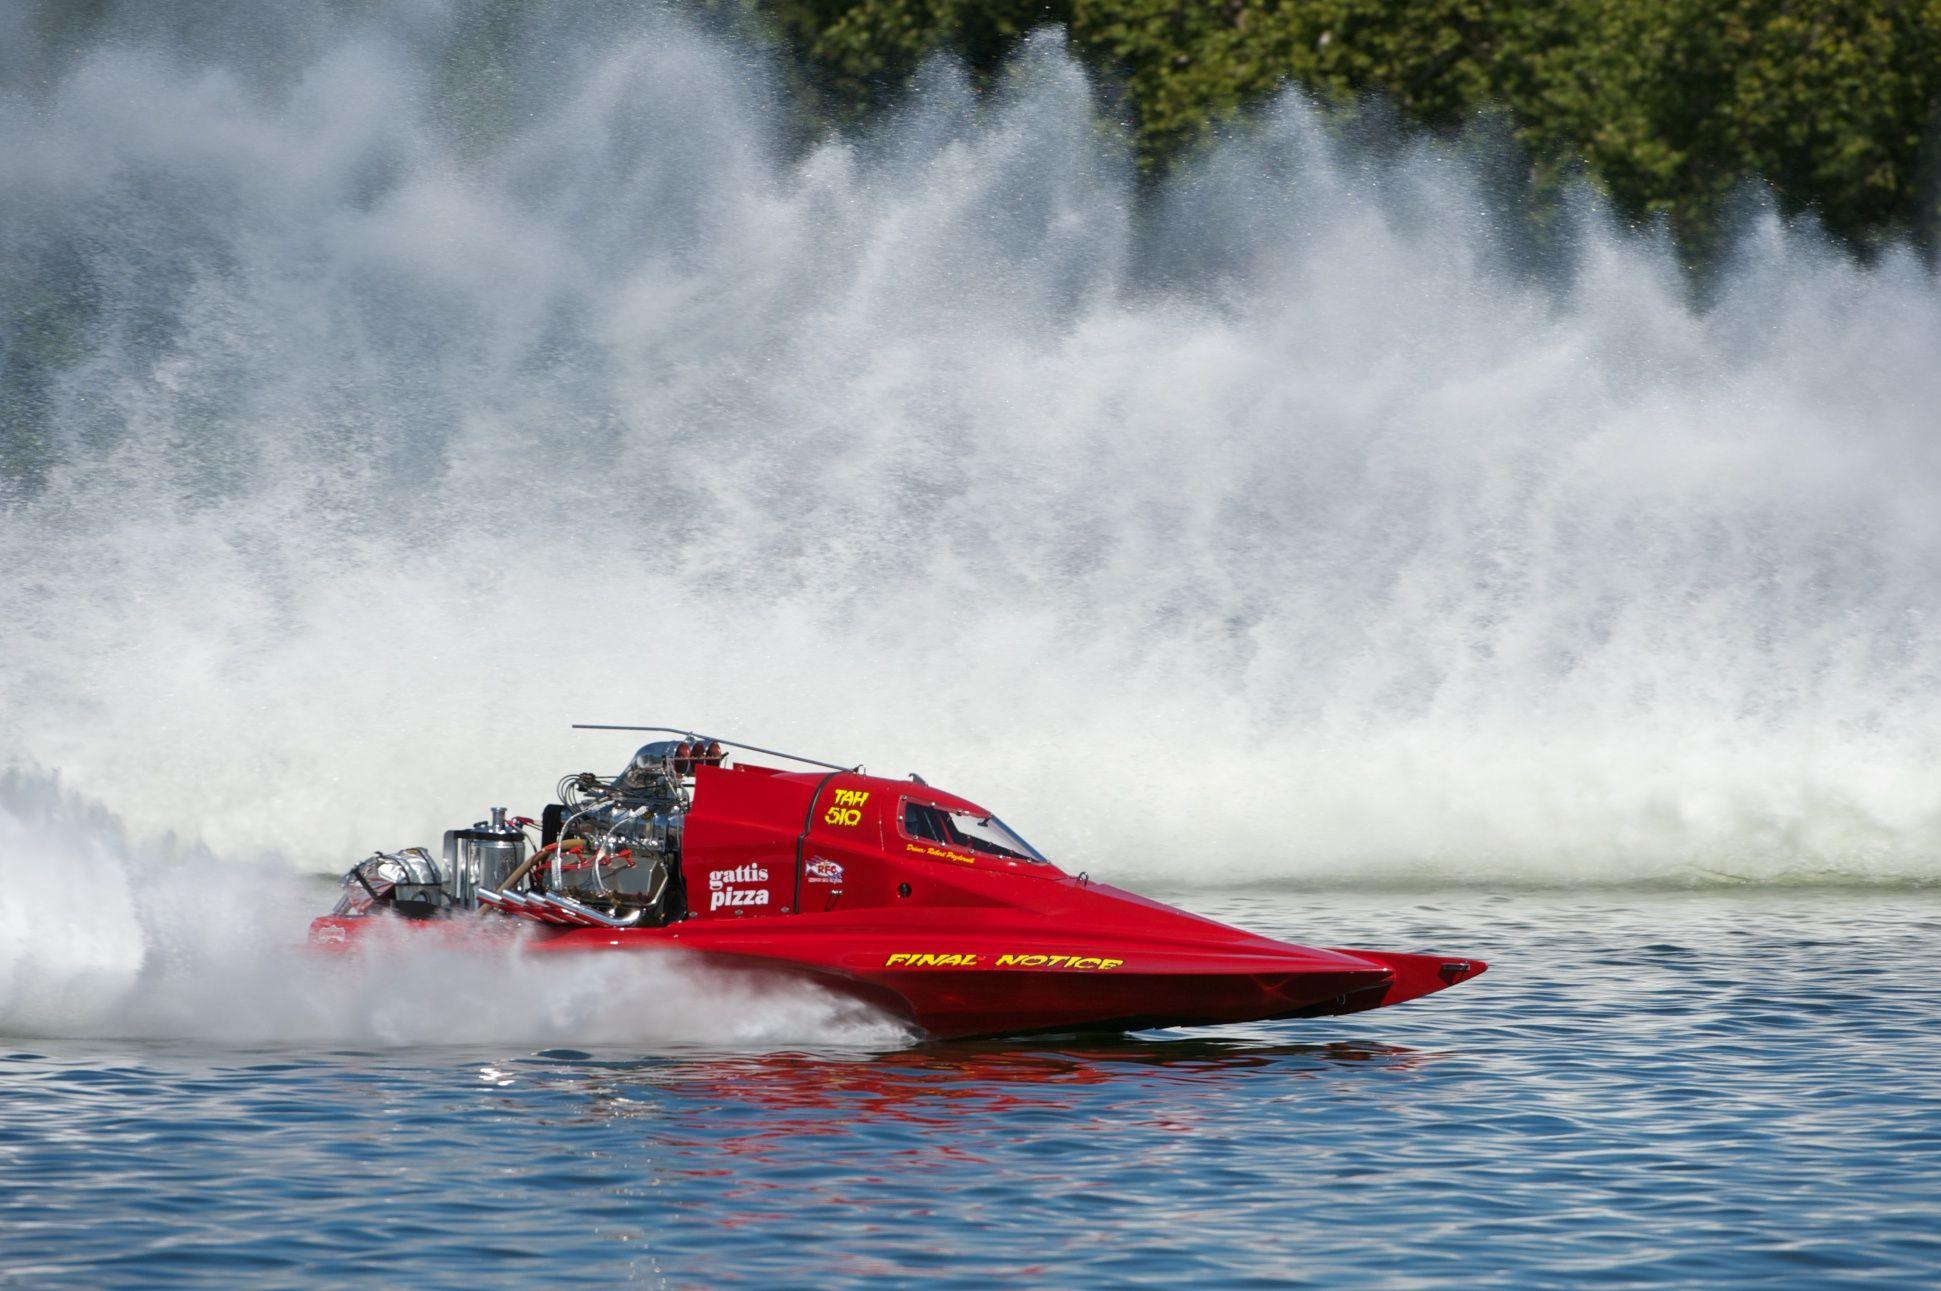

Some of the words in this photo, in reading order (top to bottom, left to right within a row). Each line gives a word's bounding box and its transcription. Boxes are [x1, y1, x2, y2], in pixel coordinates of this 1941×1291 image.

[835, 789, 869, 806] TAH
[824, 807, 861, 826] 510
[709, 862, 768, 890] gattis
[710, 886, 769, 911] pizza
[885, 954, 977, 966] FINAL
[995, 954, 1124, 970] NOTICE
